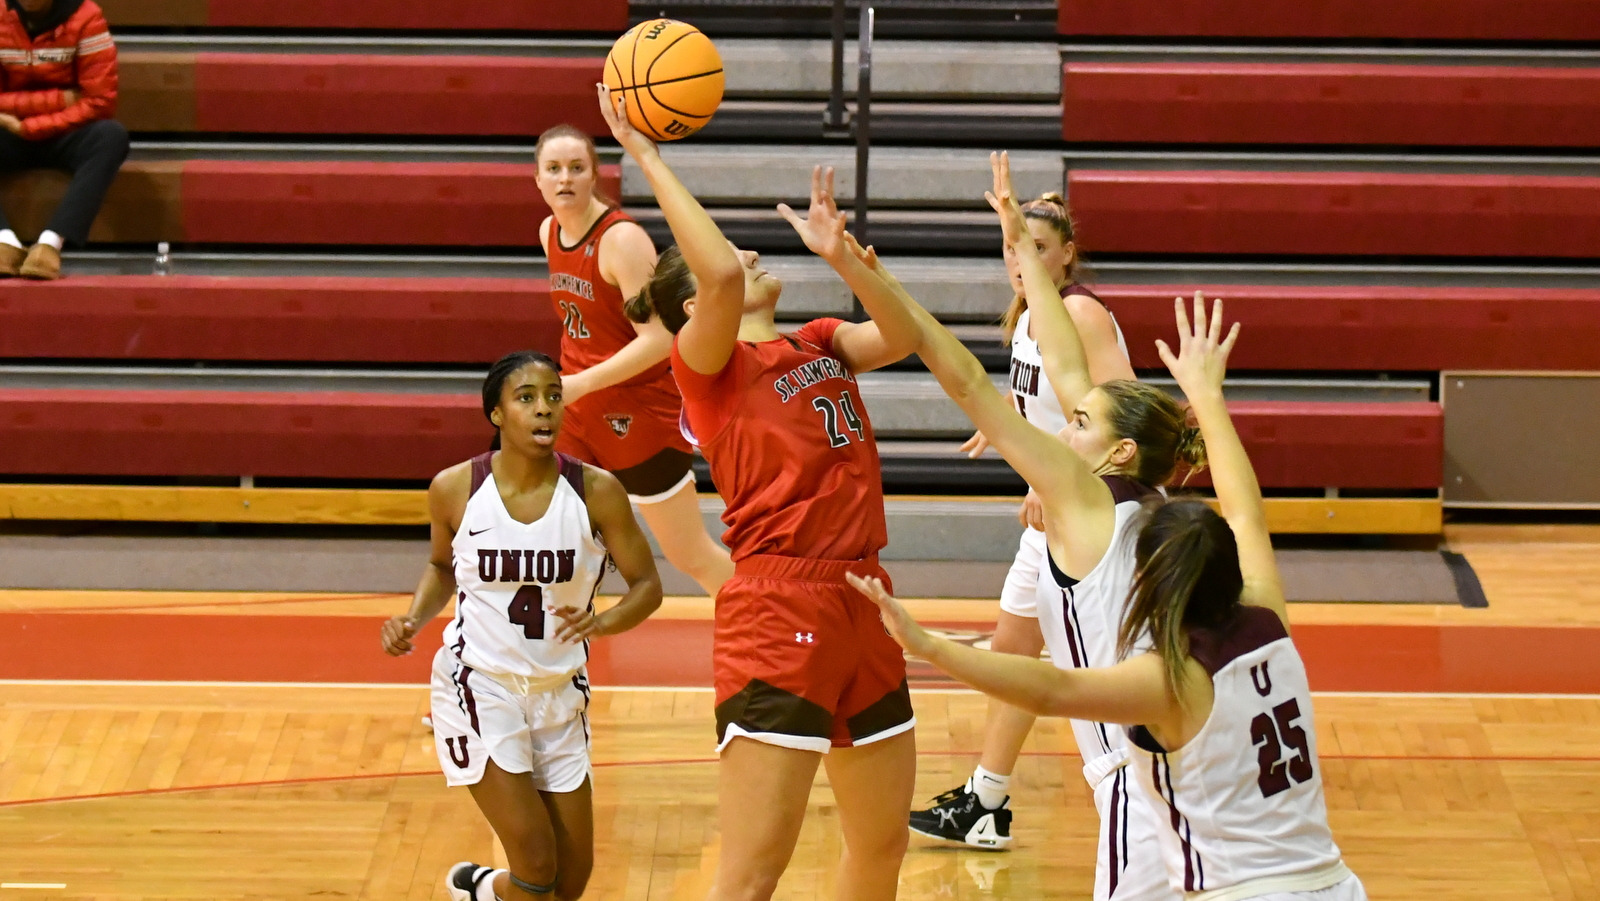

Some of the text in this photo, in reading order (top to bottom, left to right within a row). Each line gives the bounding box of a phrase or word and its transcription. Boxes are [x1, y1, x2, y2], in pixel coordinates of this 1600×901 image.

[559, 300, 590, 338] 22
[773, 374, 799, 403] ST.
[812, 390, 864, 448] 24
[477, 548, 575, 584] UNION
[507, 584, 545, 640] 4
[1250, 660, 1272, 697] U
[445, 735, 469, 769] U
[1250, 697, 1313, 799] 25
